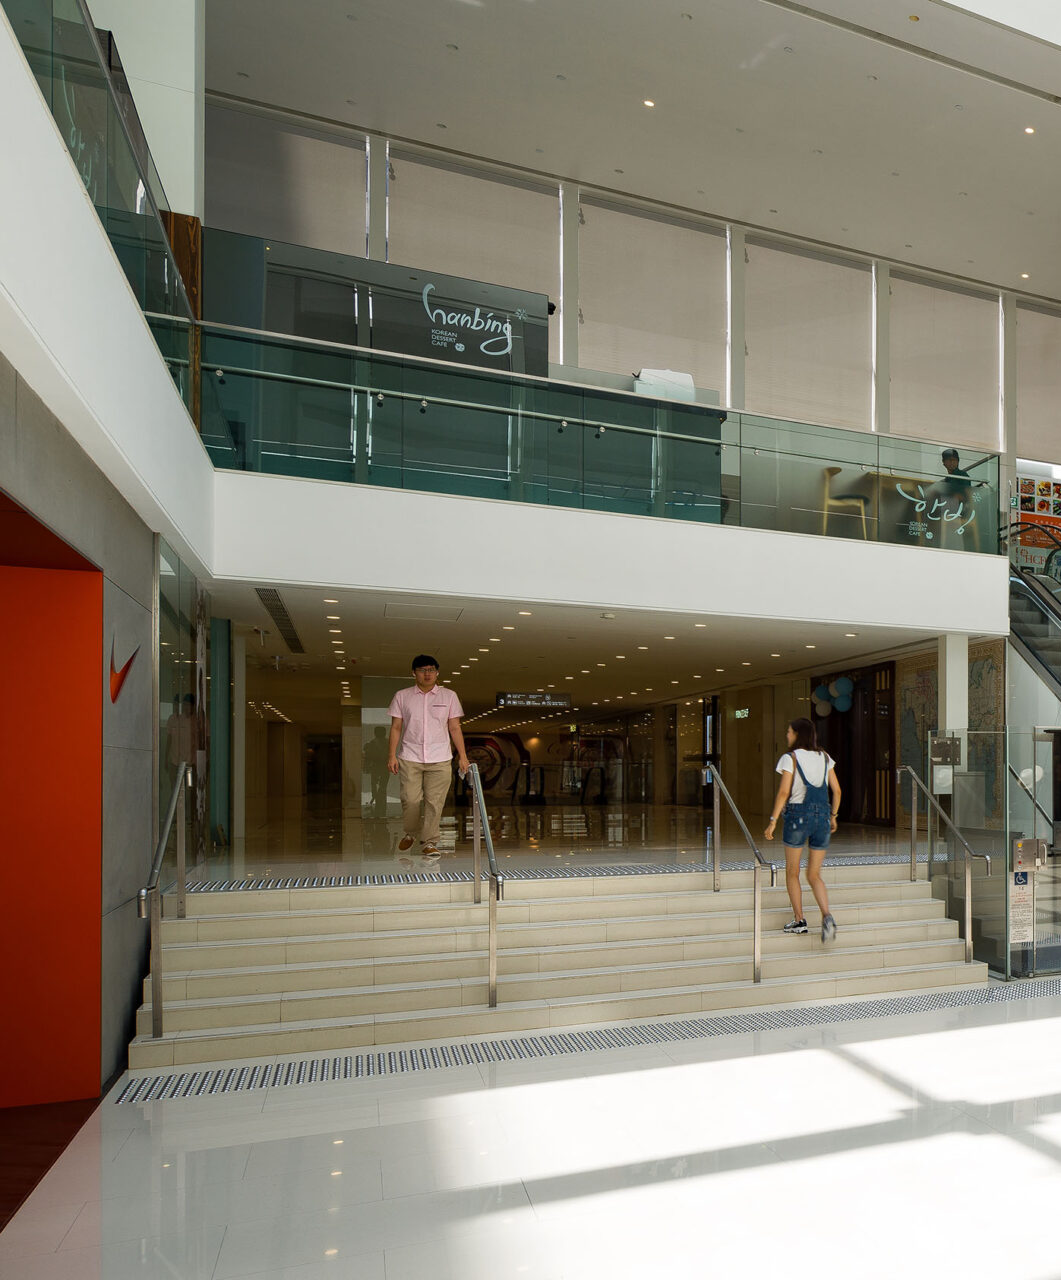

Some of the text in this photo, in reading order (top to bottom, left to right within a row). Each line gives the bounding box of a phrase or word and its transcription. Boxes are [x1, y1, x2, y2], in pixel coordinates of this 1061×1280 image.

[422, 283, 523, 355] hanbing
[431, 328, 458, 338] KOREAN
[431, 334, 457, 343] DESSERT
